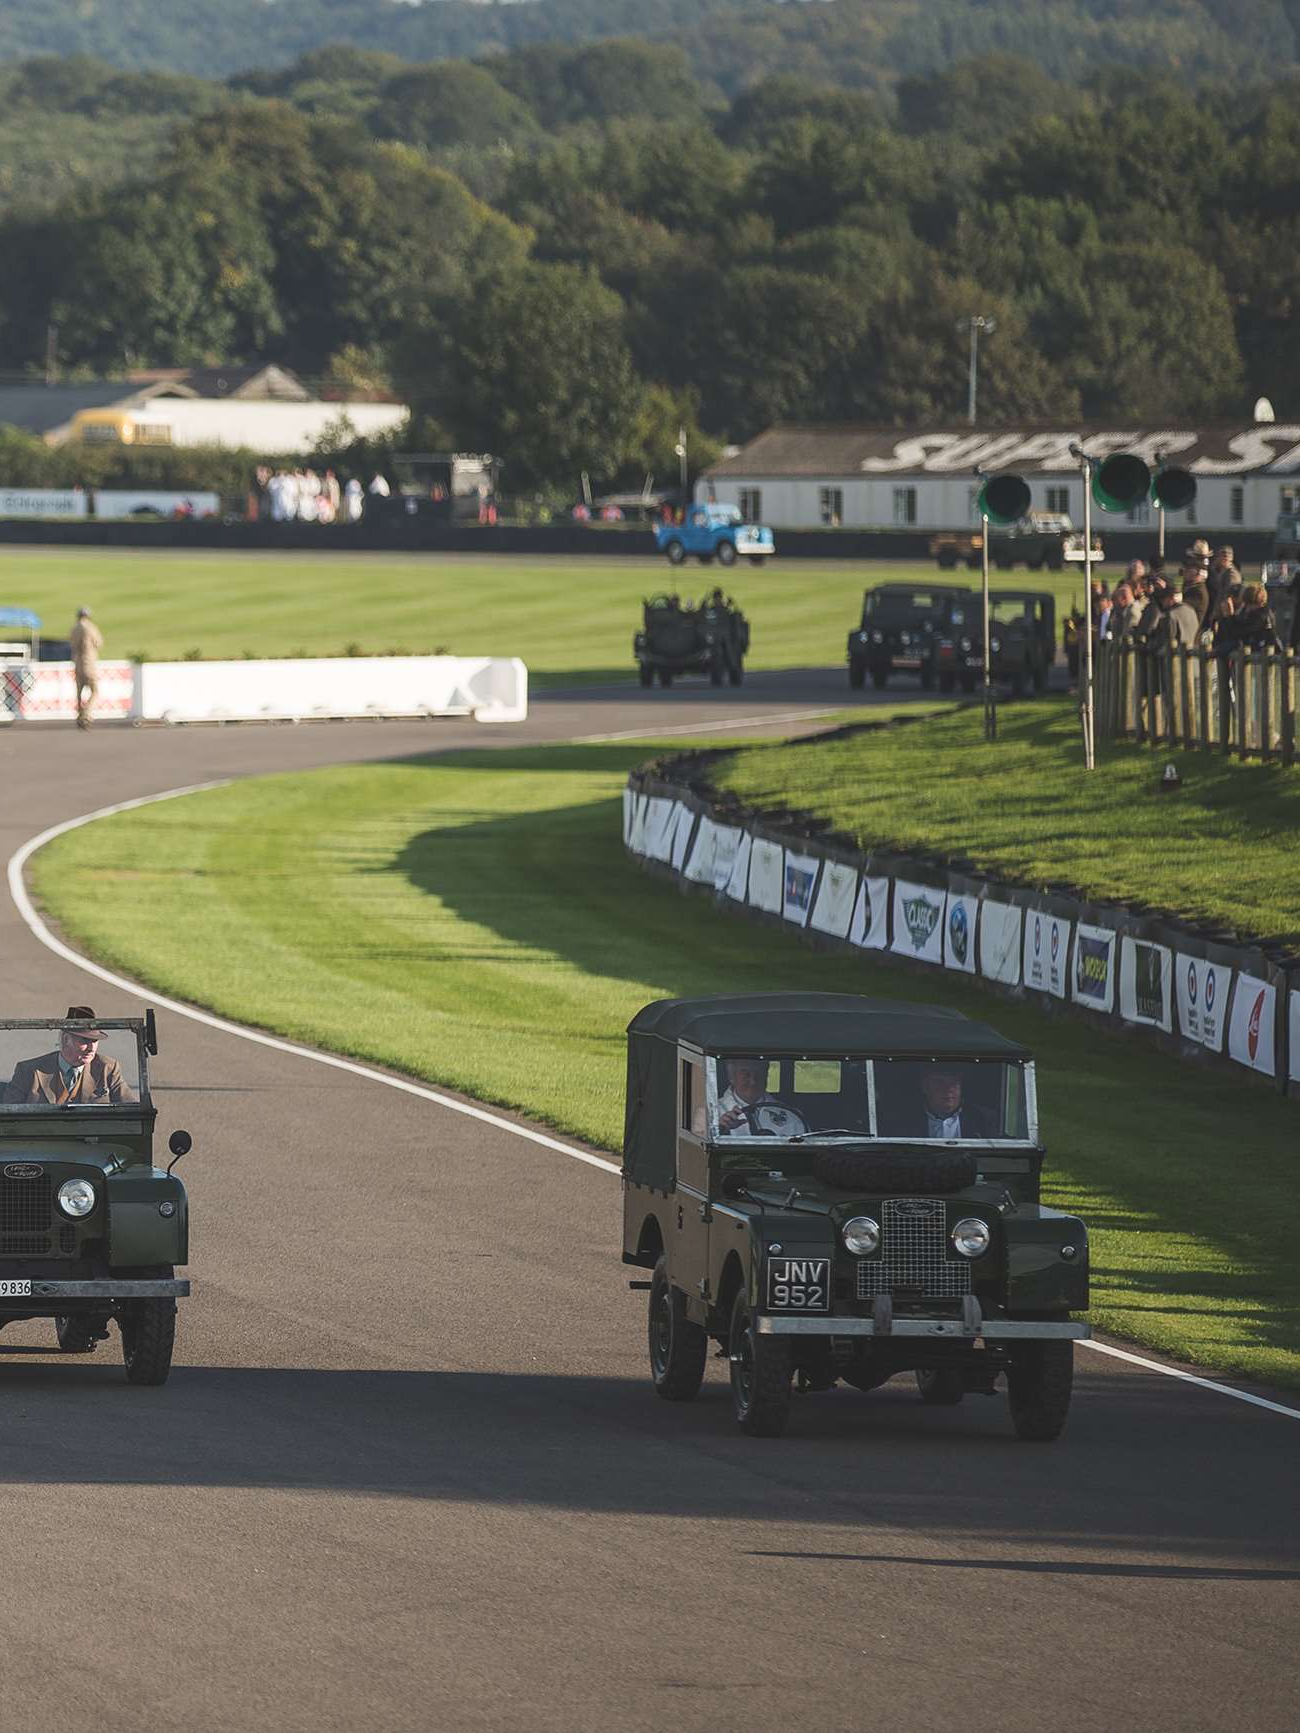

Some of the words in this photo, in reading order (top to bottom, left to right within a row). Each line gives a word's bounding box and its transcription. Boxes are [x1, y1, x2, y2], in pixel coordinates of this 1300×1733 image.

[1189, 425, 1300, 474] S
[774, 1261, 823, 1282] JNV
[774, 1285, 823, 1306] 952
